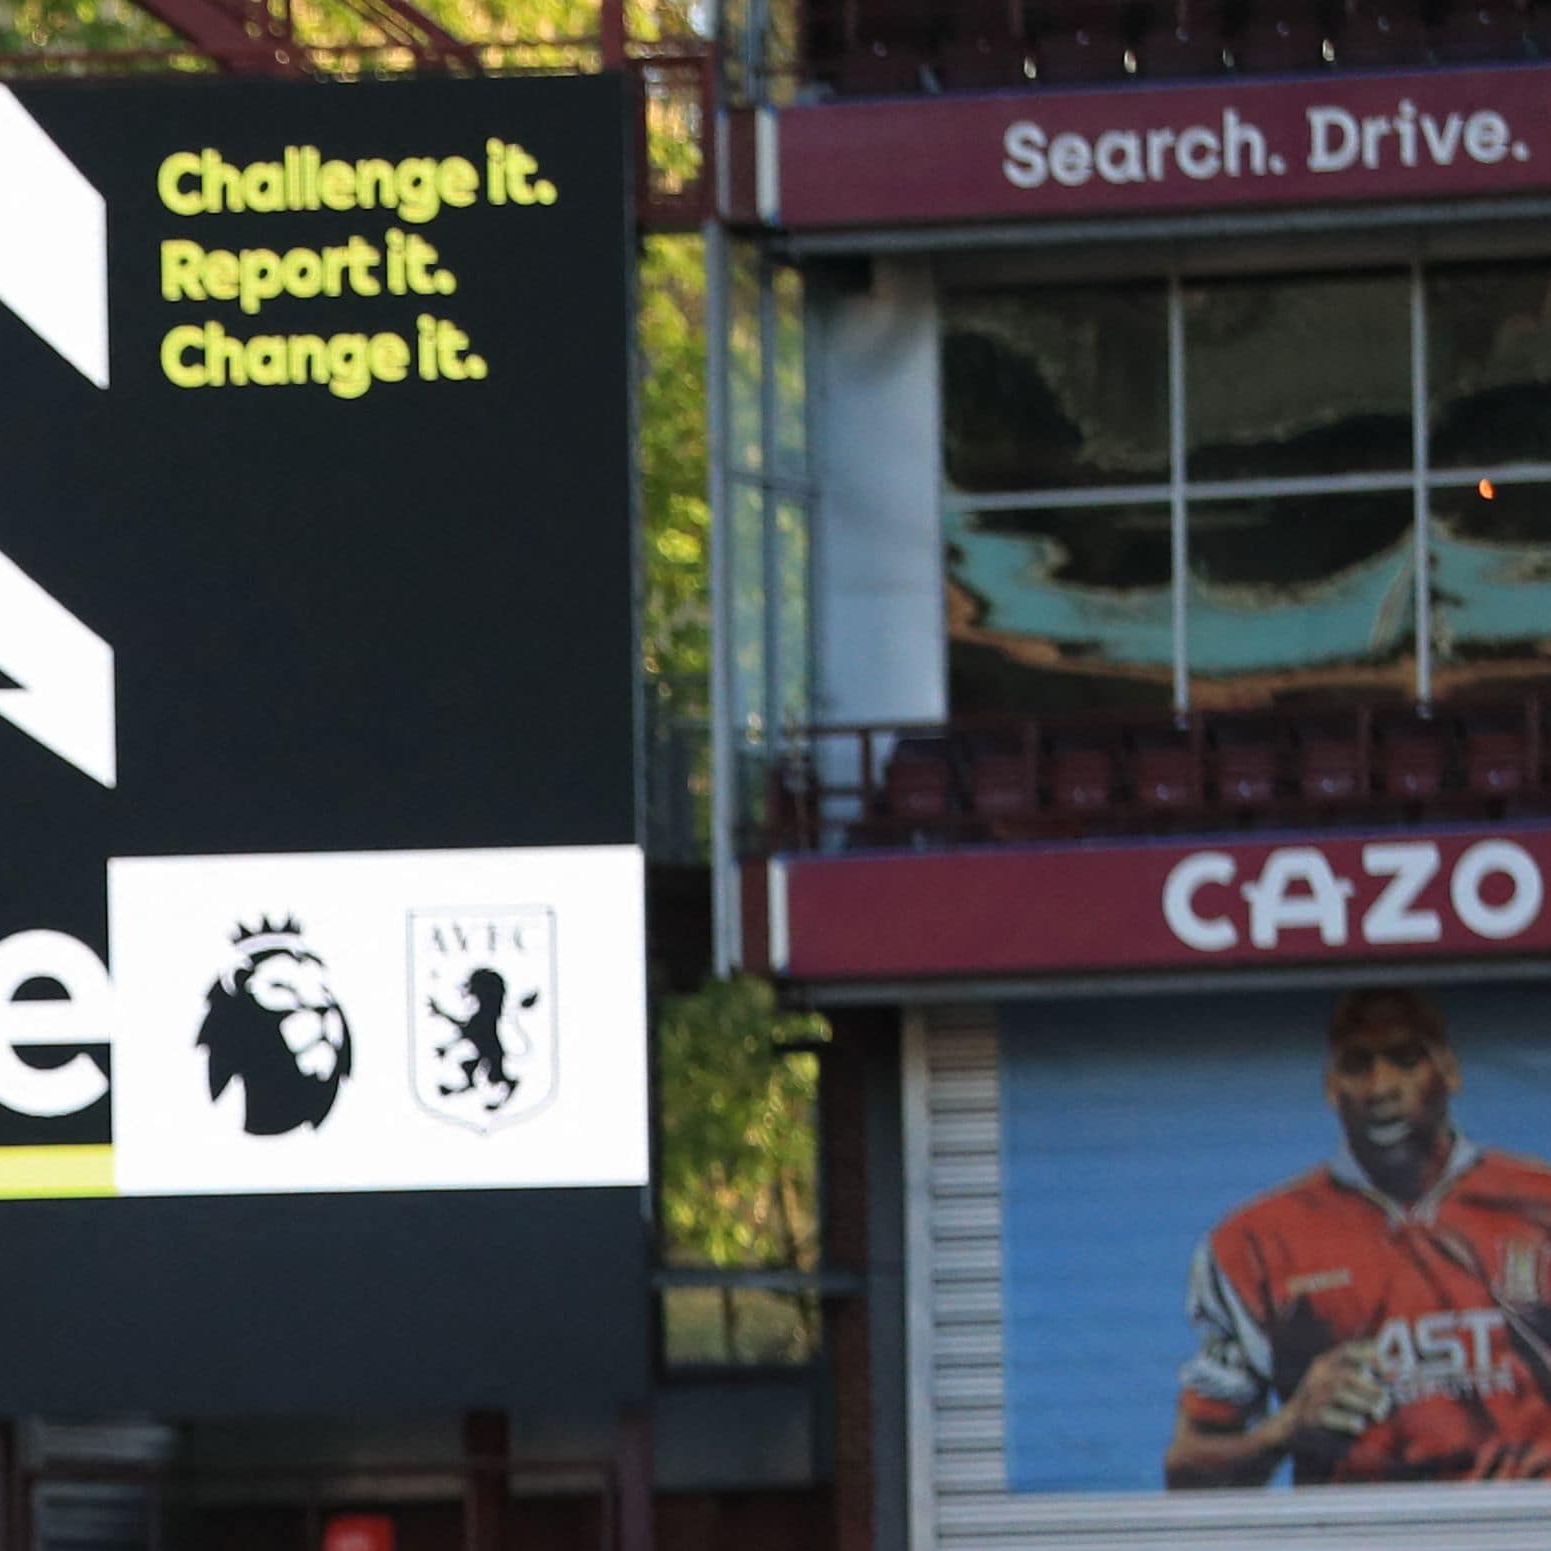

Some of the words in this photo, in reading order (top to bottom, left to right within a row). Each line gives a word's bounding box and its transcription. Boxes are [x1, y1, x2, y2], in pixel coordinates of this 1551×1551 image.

[157, 144, 480, 223] Challenge
[486, 137, 558, 206] it.
[1002, 107, 1287, 189] Search.
[1307, 99, 1531, 174] Drive.
[160, 235, 381, 314] Report
[385, 227, 457, 296] it.
[160, 320, 411, 399] Change
[416, 313, 488, 381] it.
[428, 920, 531, 956] AVFC
